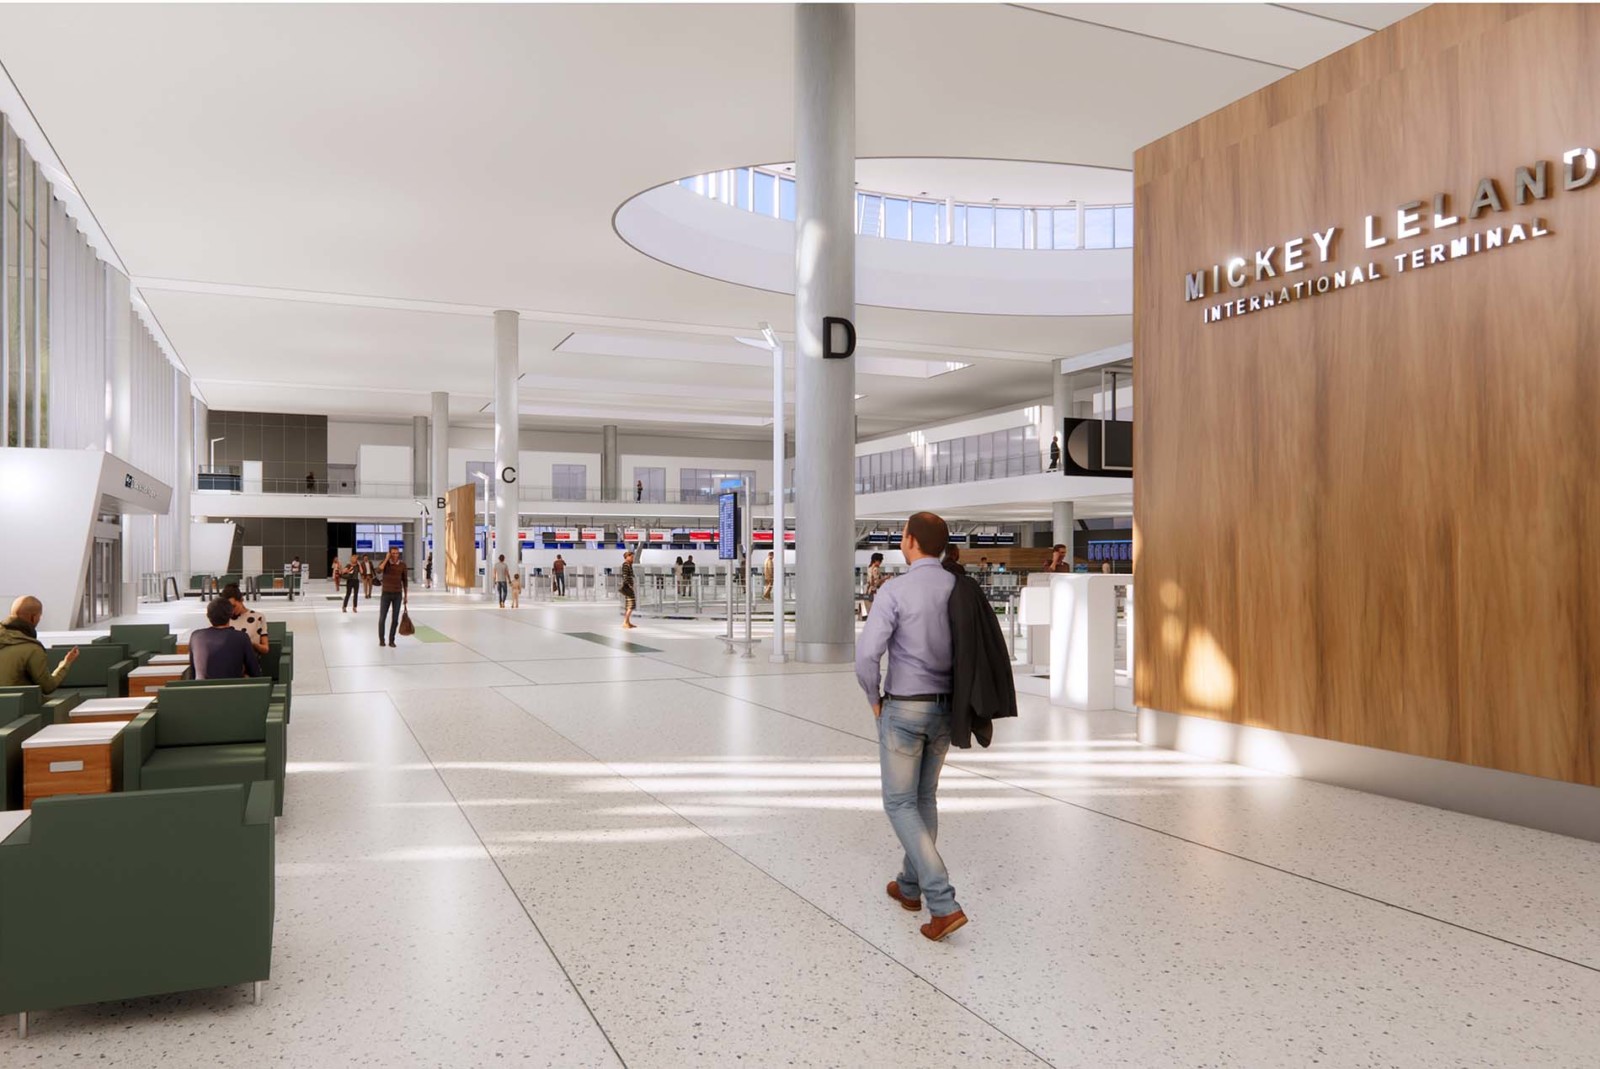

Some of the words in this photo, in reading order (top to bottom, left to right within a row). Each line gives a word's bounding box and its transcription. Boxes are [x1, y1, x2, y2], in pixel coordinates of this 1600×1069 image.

[1185, 227, 1336, 301] MICKEY
[1364, 147, 1597, 249] LELAND
[1204, 262, 1380, 324] INTERNATIONAL
[1394, 217, 1548, 272] TERMINAL
[822, 316, 856, 359] D
[501, 466, 516, 484] C
[437, 497, 446, 509] B
